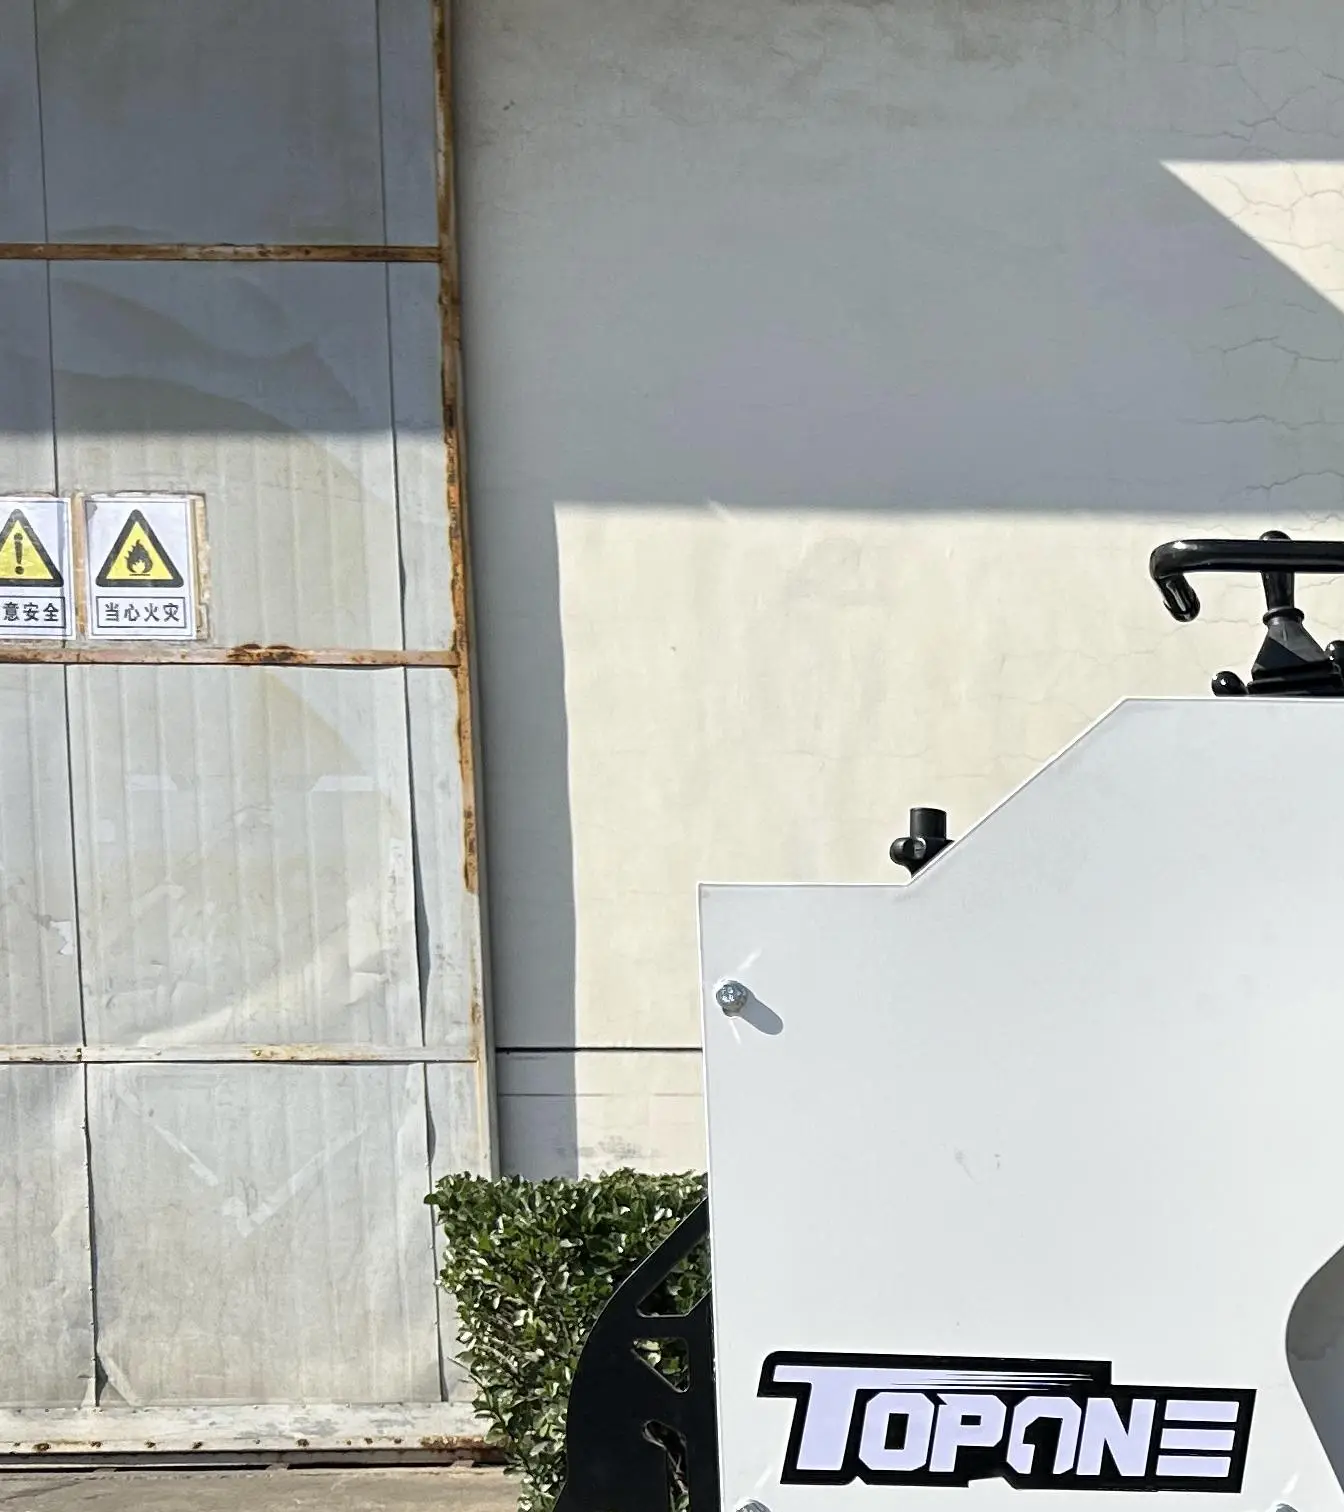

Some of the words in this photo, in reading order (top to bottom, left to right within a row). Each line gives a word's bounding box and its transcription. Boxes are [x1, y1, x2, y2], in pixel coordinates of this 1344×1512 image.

[105, 602, 180, 622] 当心火灾
[773, 1364, 1239, 1478] TOPONE
